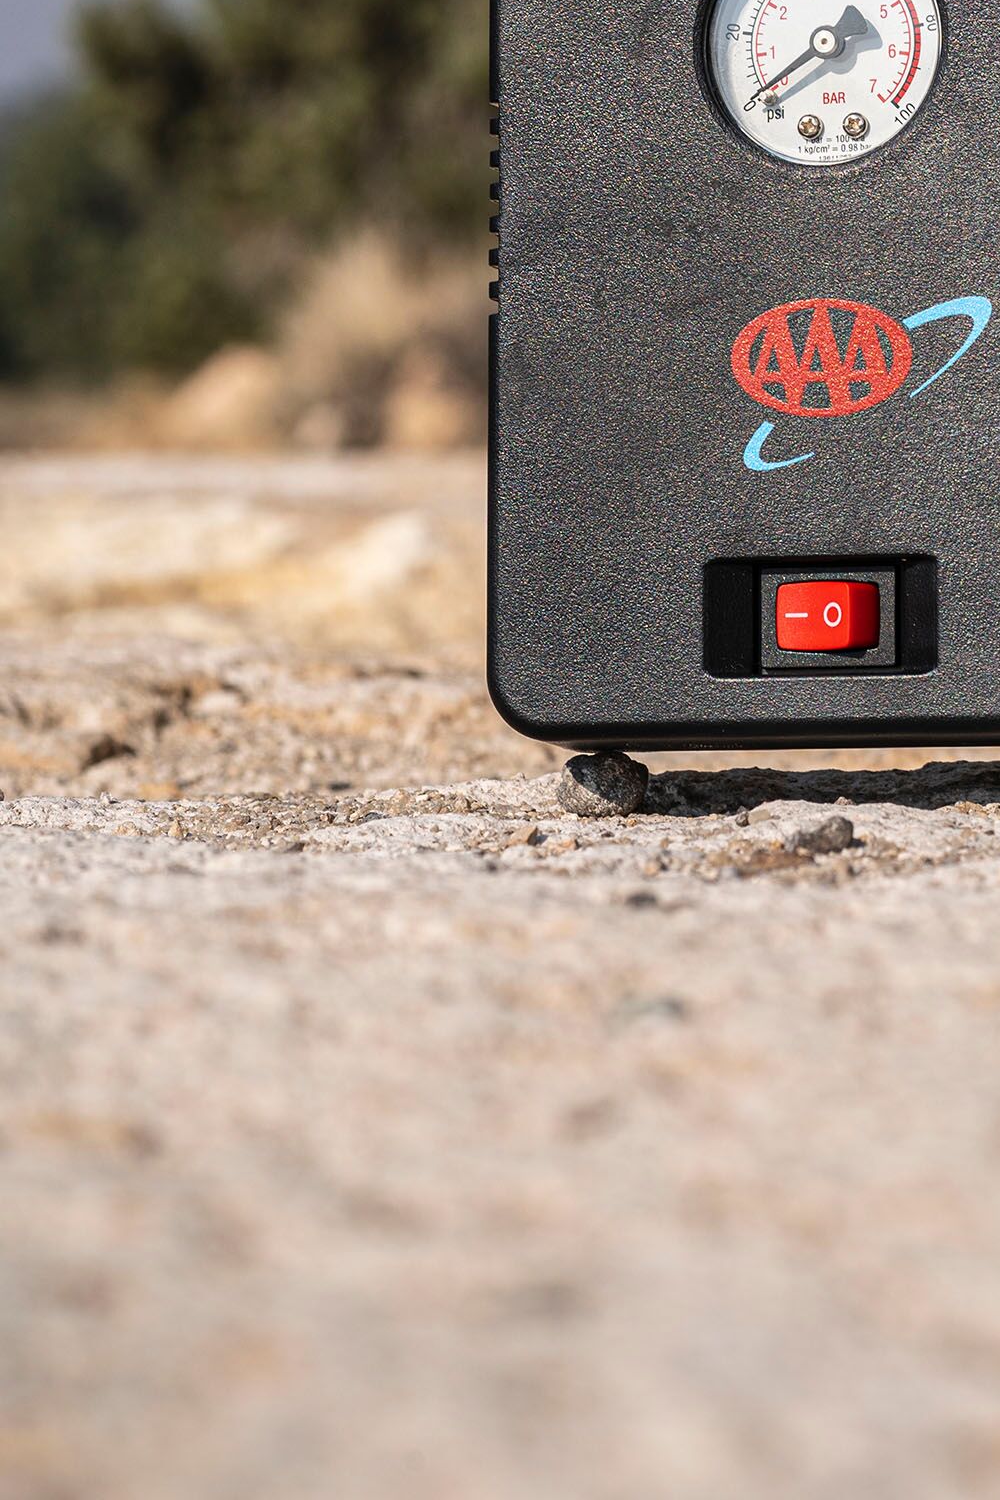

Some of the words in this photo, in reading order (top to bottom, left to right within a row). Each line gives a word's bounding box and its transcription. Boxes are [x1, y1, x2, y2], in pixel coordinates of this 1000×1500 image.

[779, 6, 788, 20] 2
[880, 4, 888, 19] 5
[726, 23, 741, 41] 20
[769, 46, 776, 59] 1
[888, 44, 896, 58] 6
[869, 79, 877, 93] 7
[822, 92, 846, 105] BAR
[743, 100, 756, 112] 0
[766, 106, 785, 123] psi
[894, 102, 916, 126] 100
[835, 134, 850, 143] 100
[840, 143, 858, 152] 0.98
[743, 299, 898, 415] AAA
